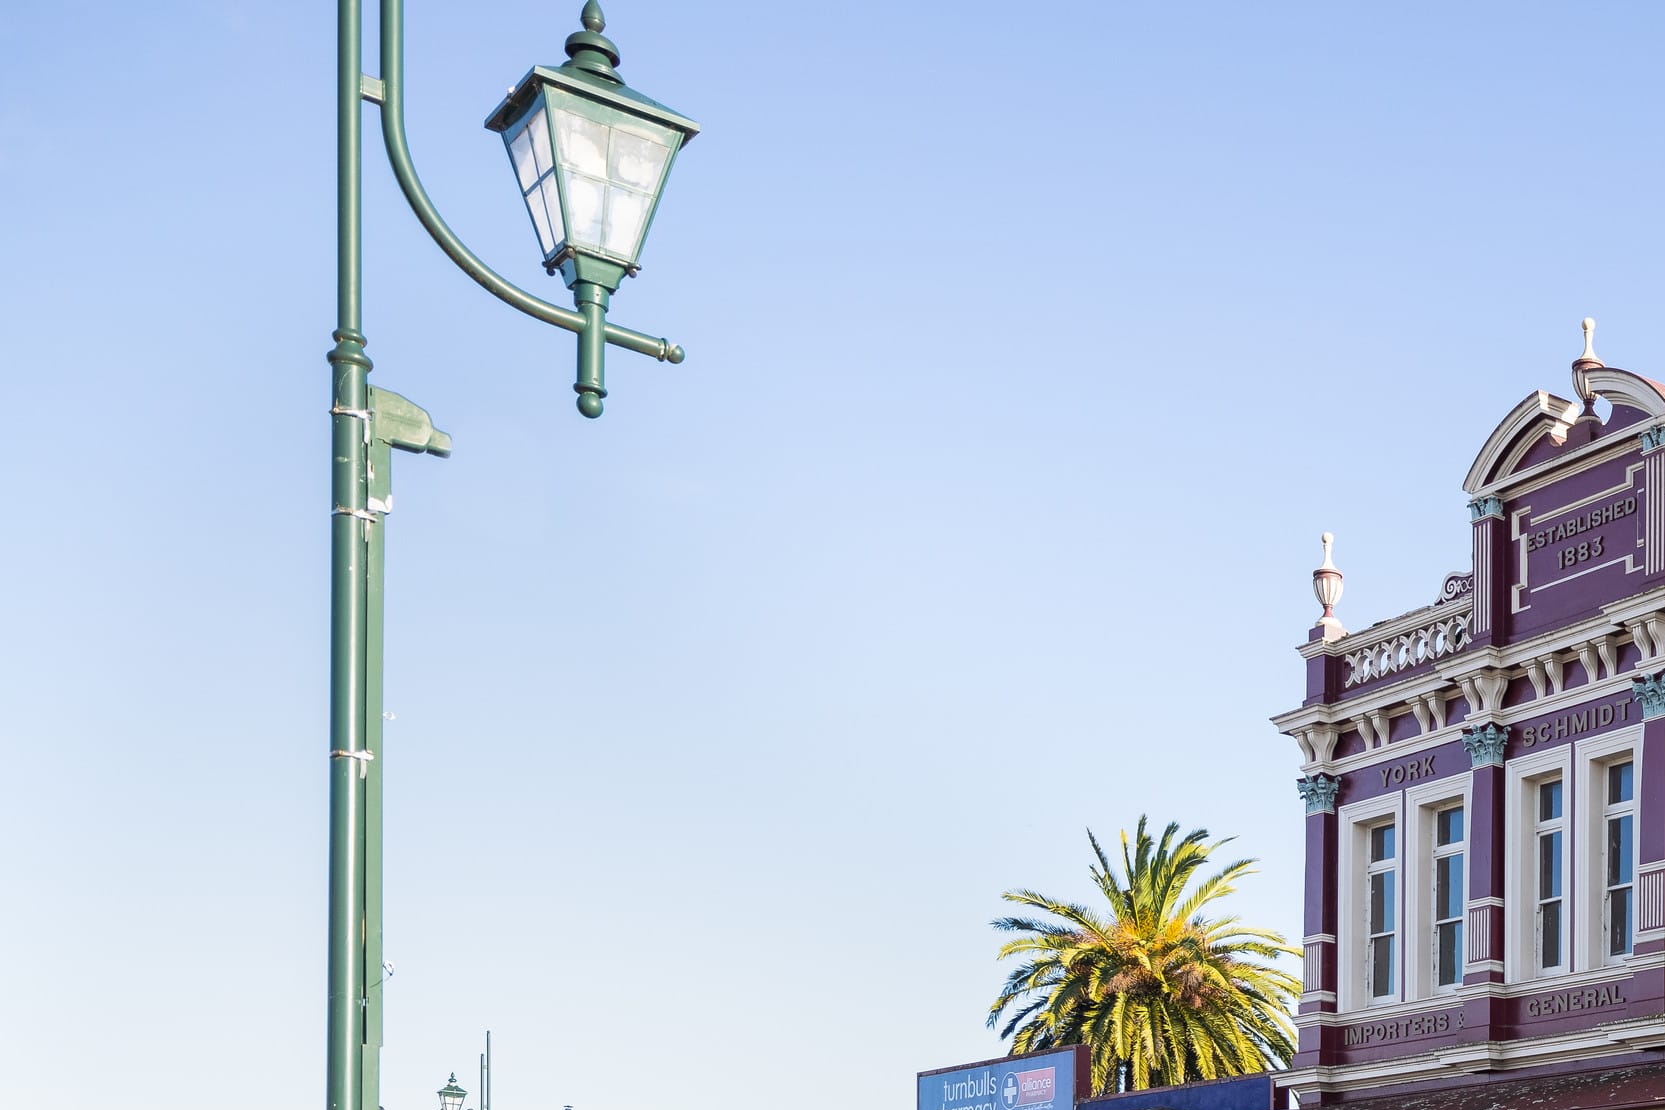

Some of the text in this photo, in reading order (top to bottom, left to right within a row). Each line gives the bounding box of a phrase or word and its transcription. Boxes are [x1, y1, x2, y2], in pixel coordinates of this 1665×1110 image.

[1527, 497, 1637, 553] ESTABLISHED
[1557, 536, 1604, 570] 1883
[1522, 699, 1633, 747] SCHMIDT
[1379, 755, 1436, 787] YORK
[1527, 985, 1625, 1017] GENERAL
[1344, 1011, 1465, 1046] IMPORTERS &
[943, 1071, 997, 1103] turnbulls
[1021, 1078, 1051, 1091] alliance
